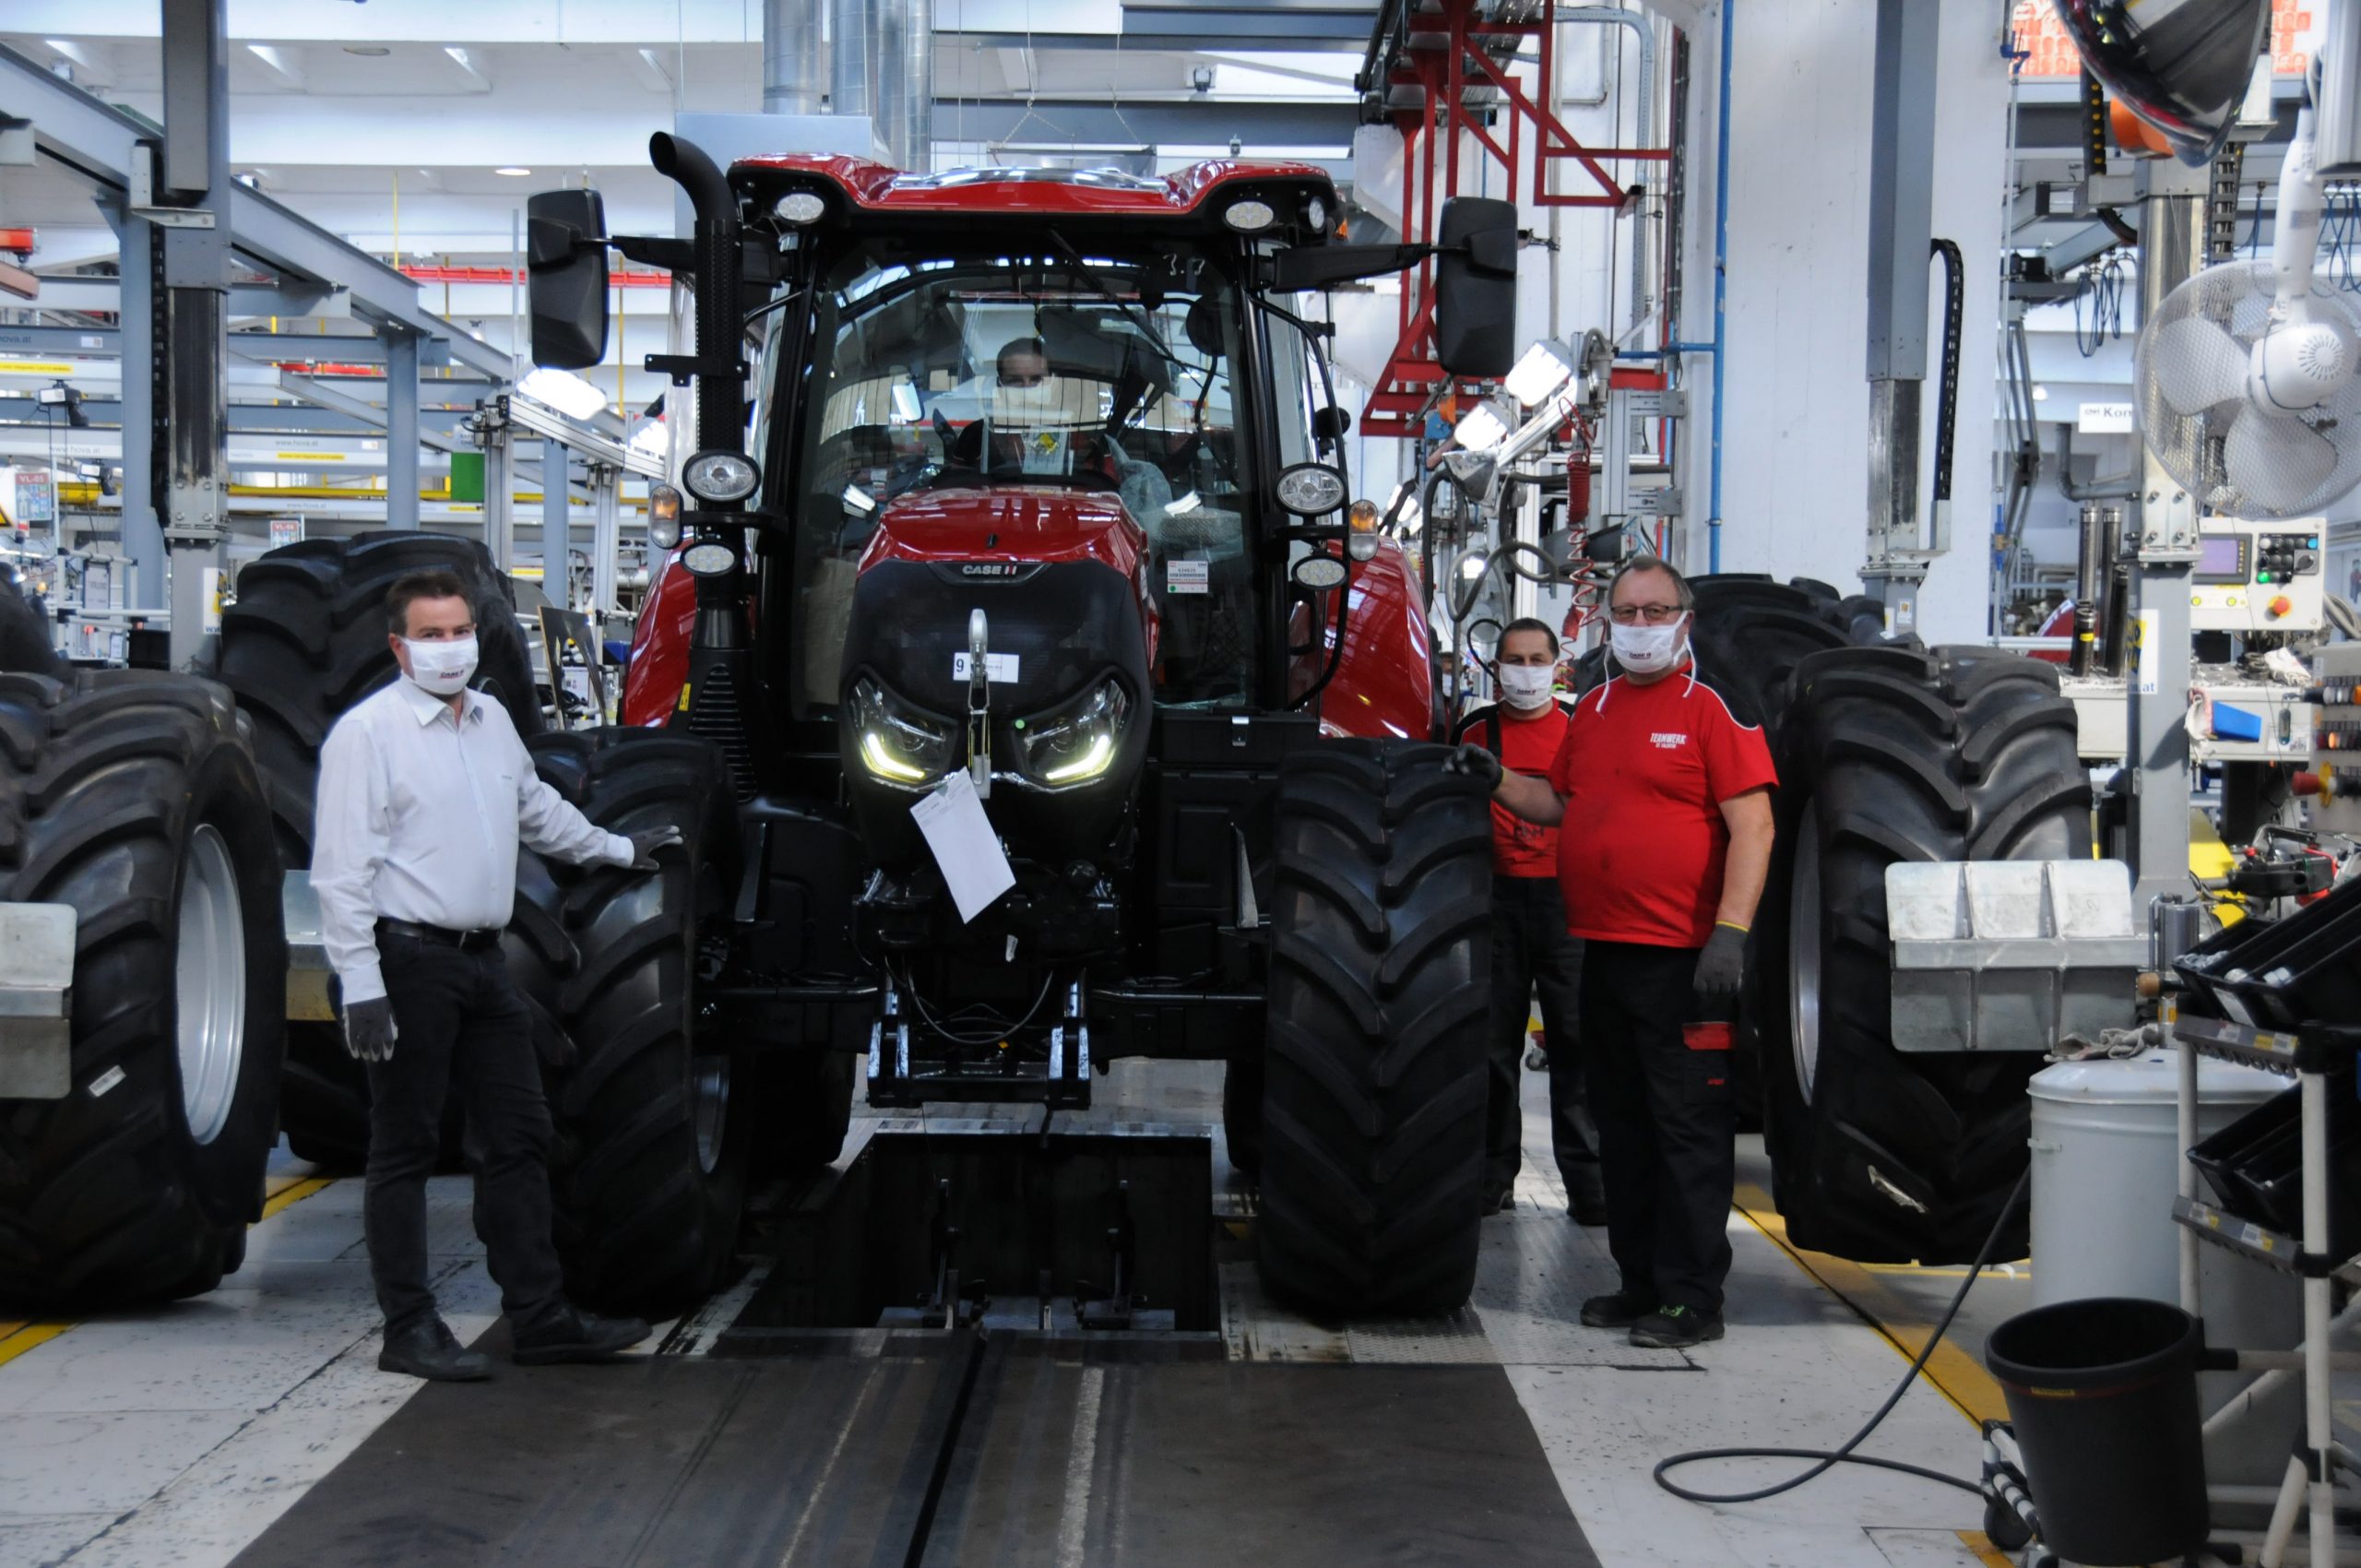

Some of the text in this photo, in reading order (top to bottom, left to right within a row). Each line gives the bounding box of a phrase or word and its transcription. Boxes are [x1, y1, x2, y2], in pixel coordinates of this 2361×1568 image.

[962, 564, 1003, 576] CASE
[955, 658, 965, 672] 9
[1650, 732, 1687, 745] TEAMWERK
